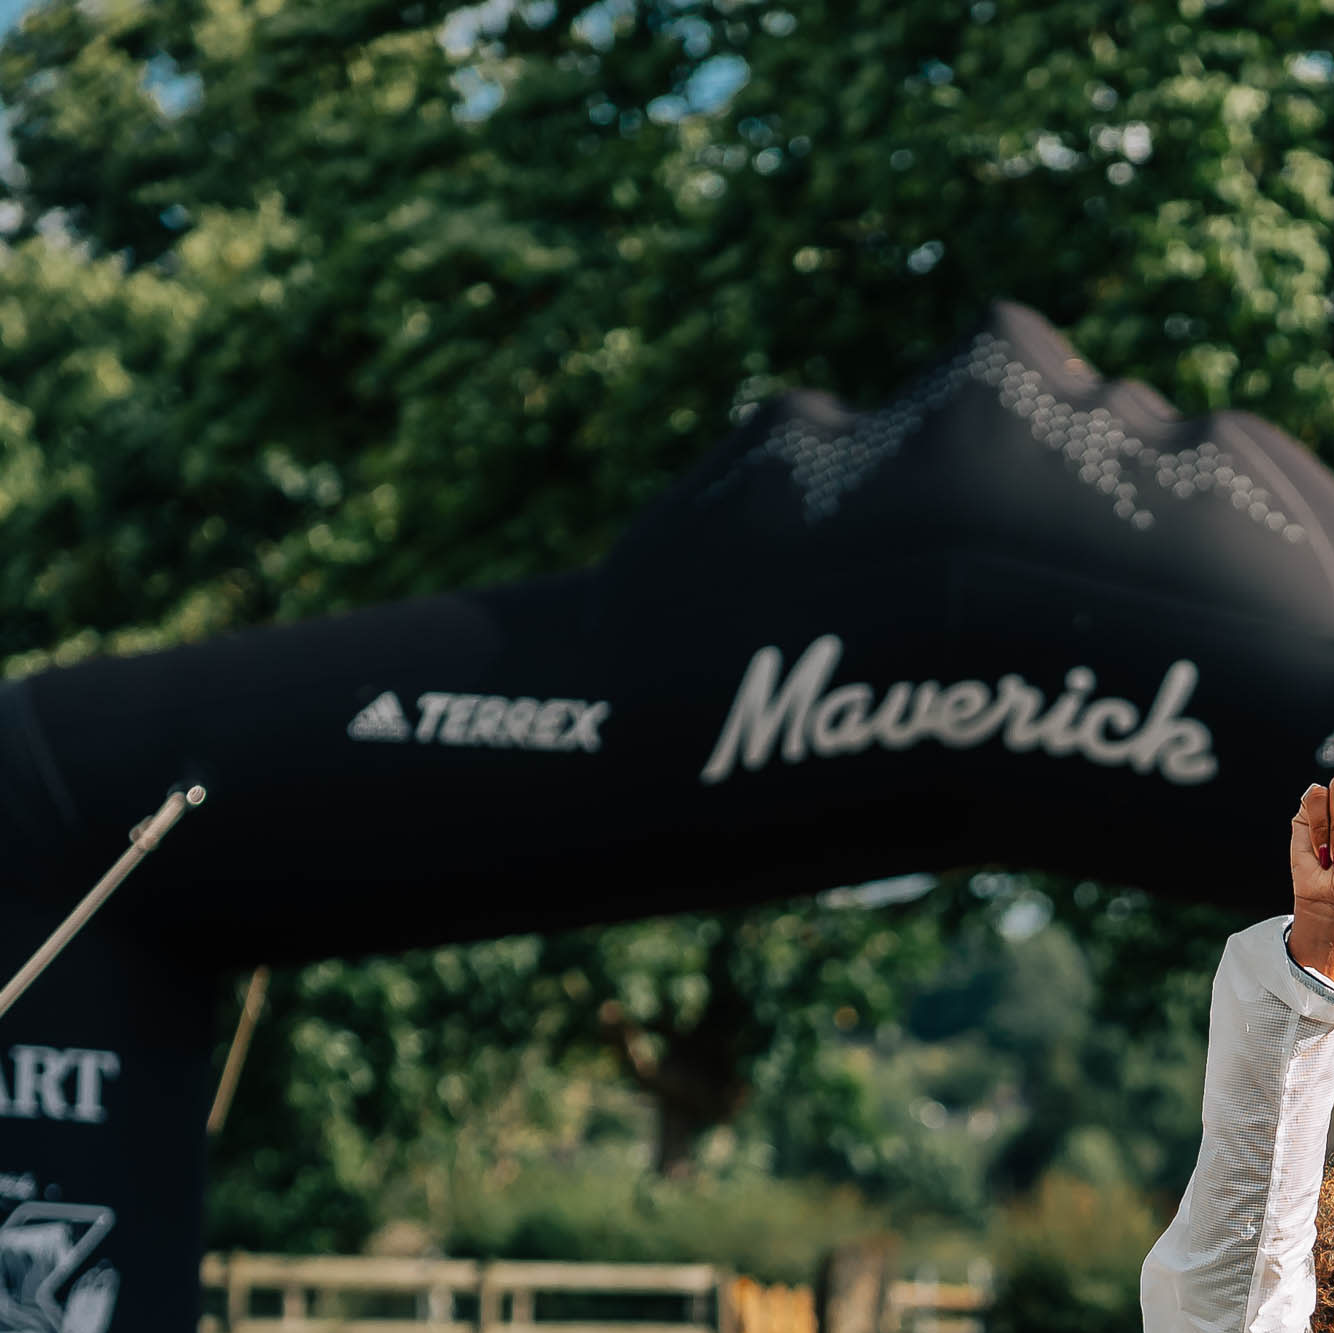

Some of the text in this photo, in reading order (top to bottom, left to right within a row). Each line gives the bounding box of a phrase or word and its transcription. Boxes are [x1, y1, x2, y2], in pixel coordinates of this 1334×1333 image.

[414, 690, 611, 754] TERREX
[701, 633, 1219, 785] Maverick
[0, 1044, 121, 1124] RT
